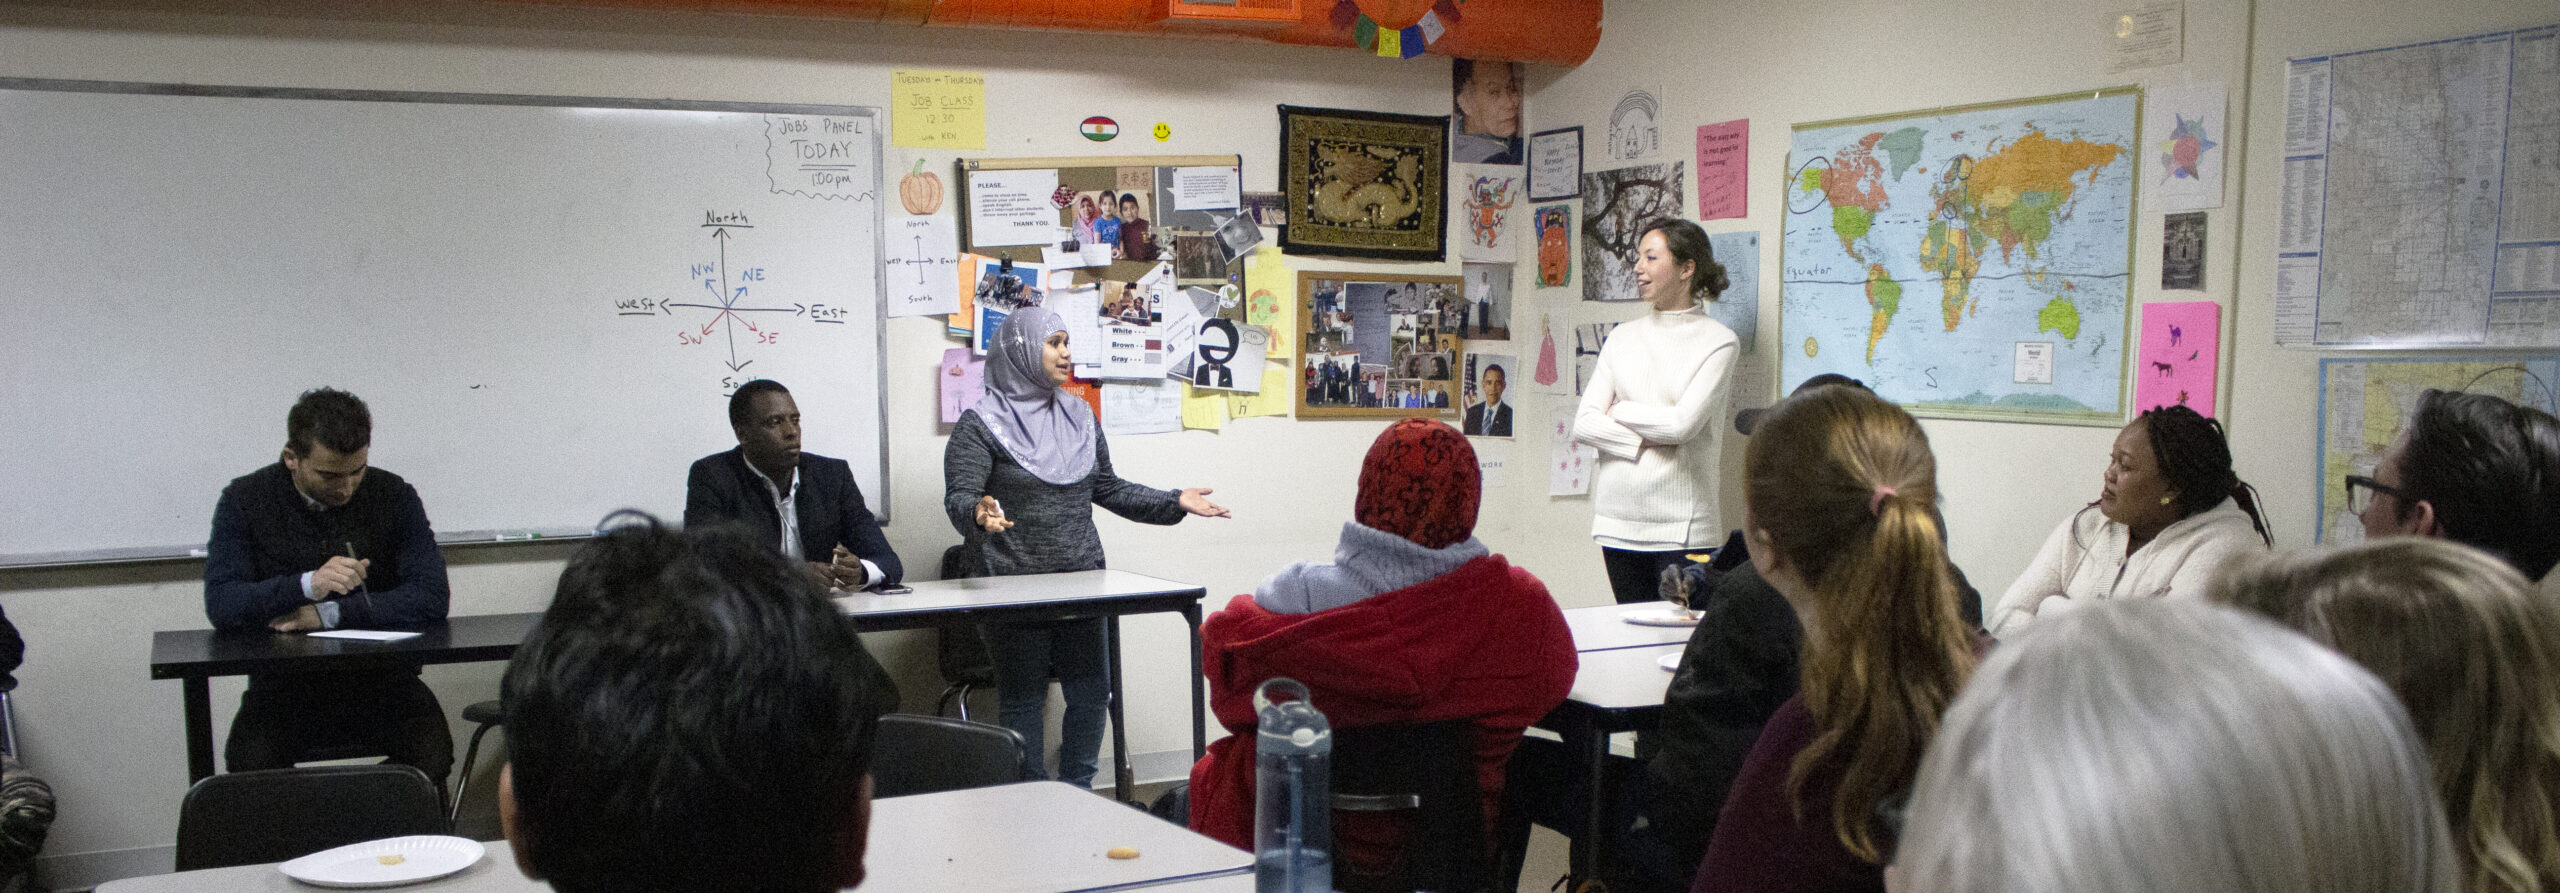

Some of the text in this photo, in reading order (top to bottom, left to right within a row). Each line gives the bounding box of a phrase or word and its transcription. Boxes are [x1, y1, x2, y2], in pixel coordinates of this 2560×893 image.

[911, 94, 974, 107] JOB CLASS
[778, 117, 863, 135] JOBS PANEL
[790, 140, 852, 159] TODAY
[706, 210, 748, 224] North
[906, 220, 930, 229] North
[691, 262, 715, 280] NW
[742, 268, 765, 281] NE
[908, 294, 933, 304] South
[811, 304, 848, 319] East
[679, 332, 779, 345] SW SE
[1111, 355, 1128, 363] Gray
